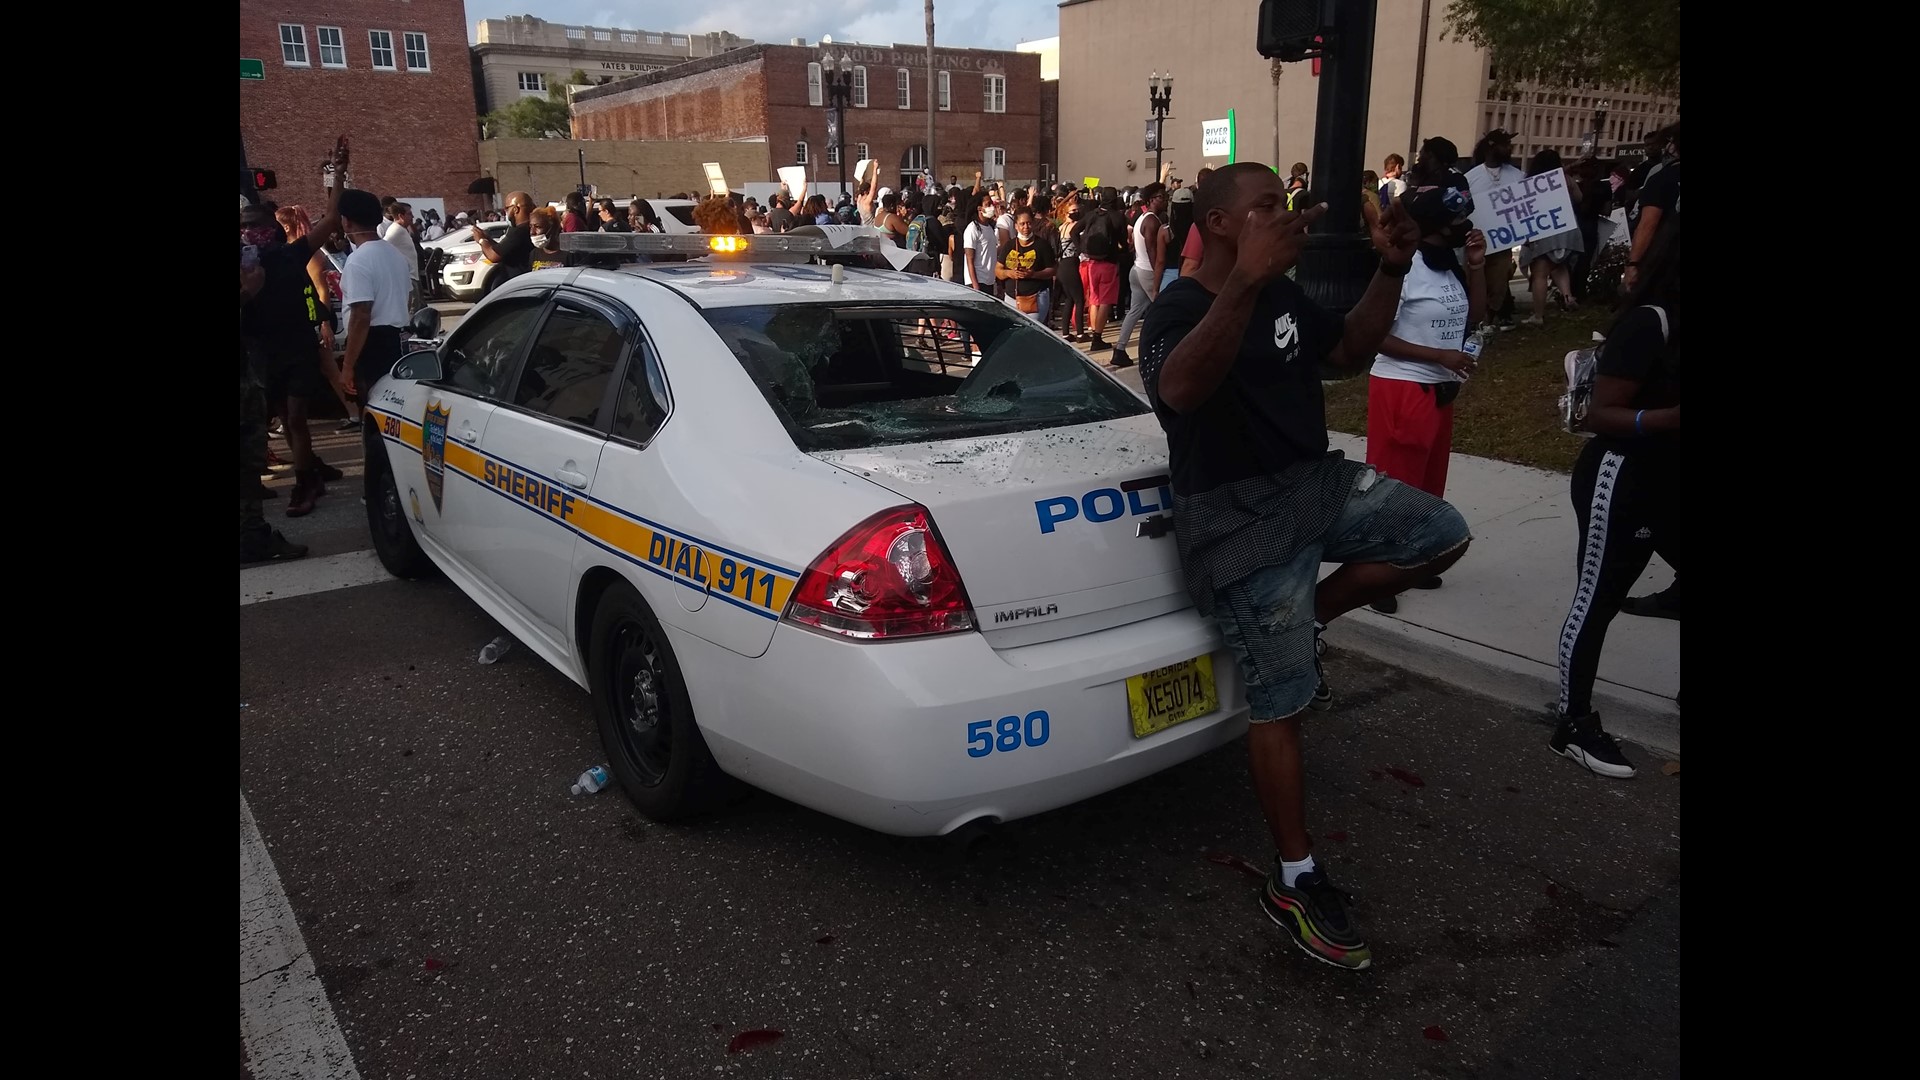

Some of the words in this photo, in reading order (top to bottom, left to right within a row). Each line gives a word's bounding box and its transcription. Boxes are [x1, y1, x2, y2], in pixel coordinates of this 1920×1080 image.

[601, 62, 626, 70] YATES
[1205, 127, 1228, 136] RIVER
[1205, 137, 1227, 145] WALK
[1488, 170, 1562, 209] POLICE
[1496, 198, 1539, 224] THE
[1487, 206, 1567, 249] POLICE
[1431, 319, 1446, 328] I'D
[384, 415, 401, 438] 580
[484, 459, 575, 521] SHERIFF
[1035, 487, 1172, 535] POLI
[648, 531, 707, 584] DIAL
[718, 557, 776, 609] 911
[994, 603, 1059, 623] IMPALA
[1150, 661, 1189, 680] FLORIDA
[1144, 671, 1204, 719] XE5074
[1168, 709, 1186, 722] CITY
[967, 709, 1050, 758] 580
